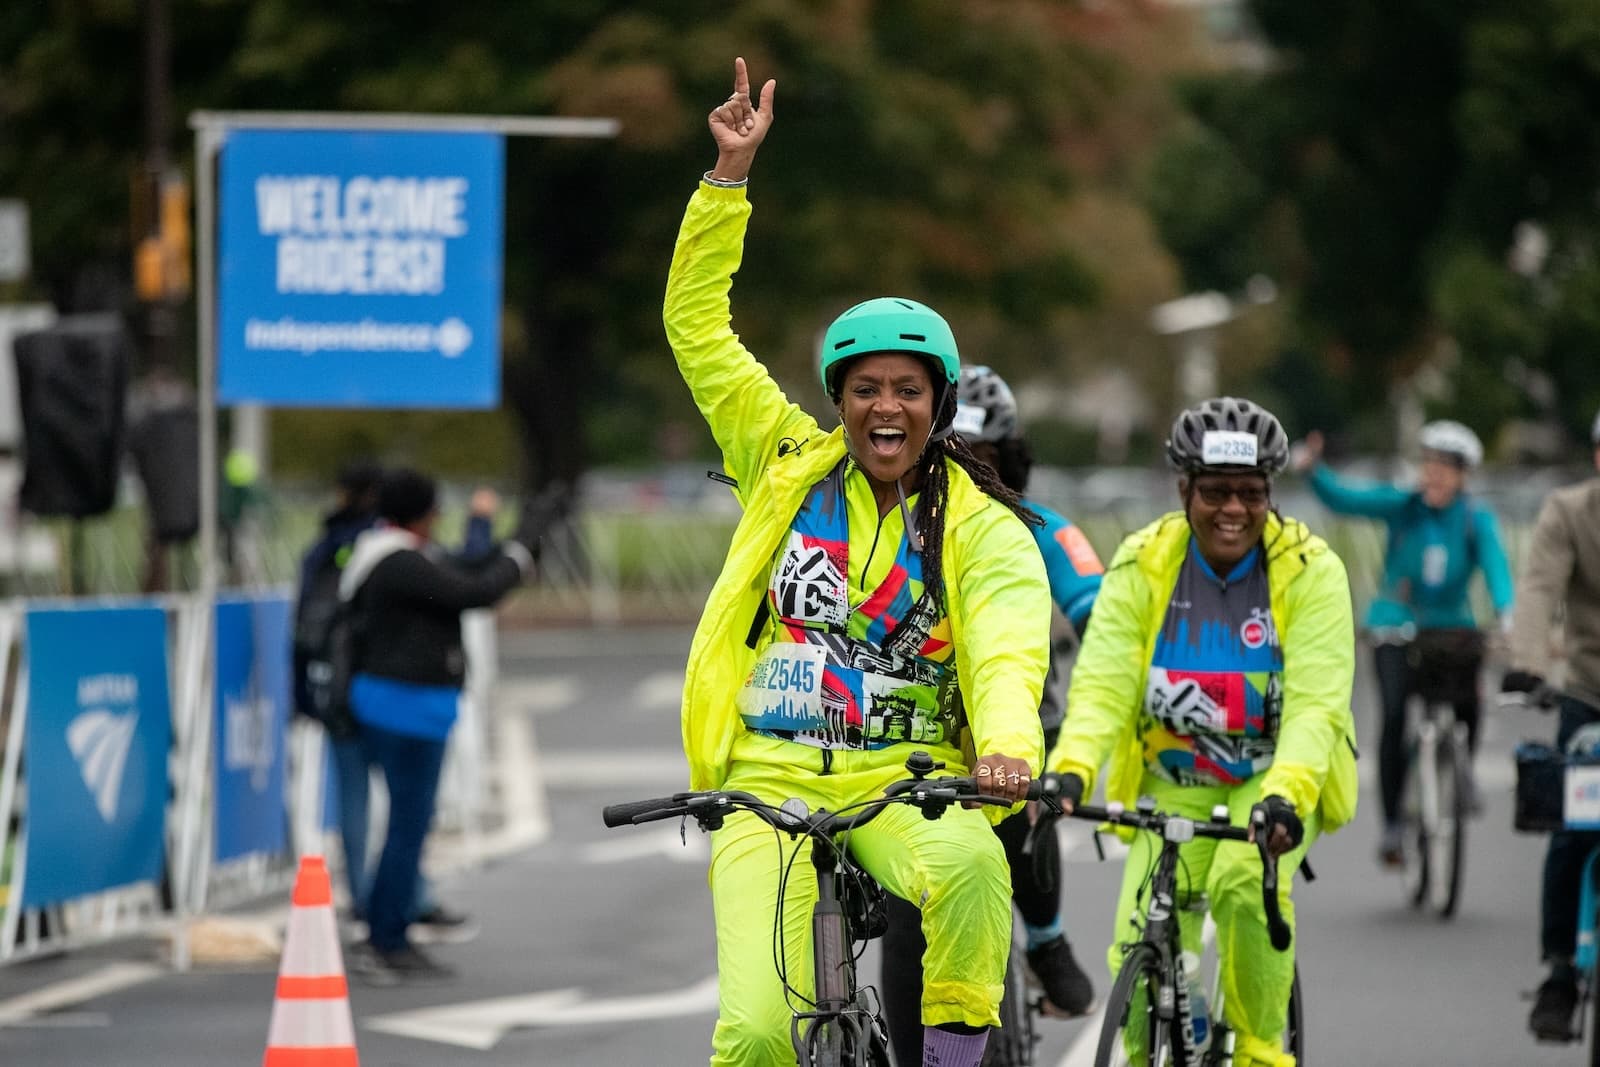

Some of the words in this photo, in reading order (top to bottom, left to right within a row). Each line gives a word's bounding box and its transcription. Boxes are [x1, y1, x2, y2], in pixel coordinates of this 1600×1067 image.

[255, 175, 468, 236] WELCOME
[277, 237, 445, 294] RIDERS!
[245, 317, 432, 354] Independence
[768, 657, 815, 693] 2545
